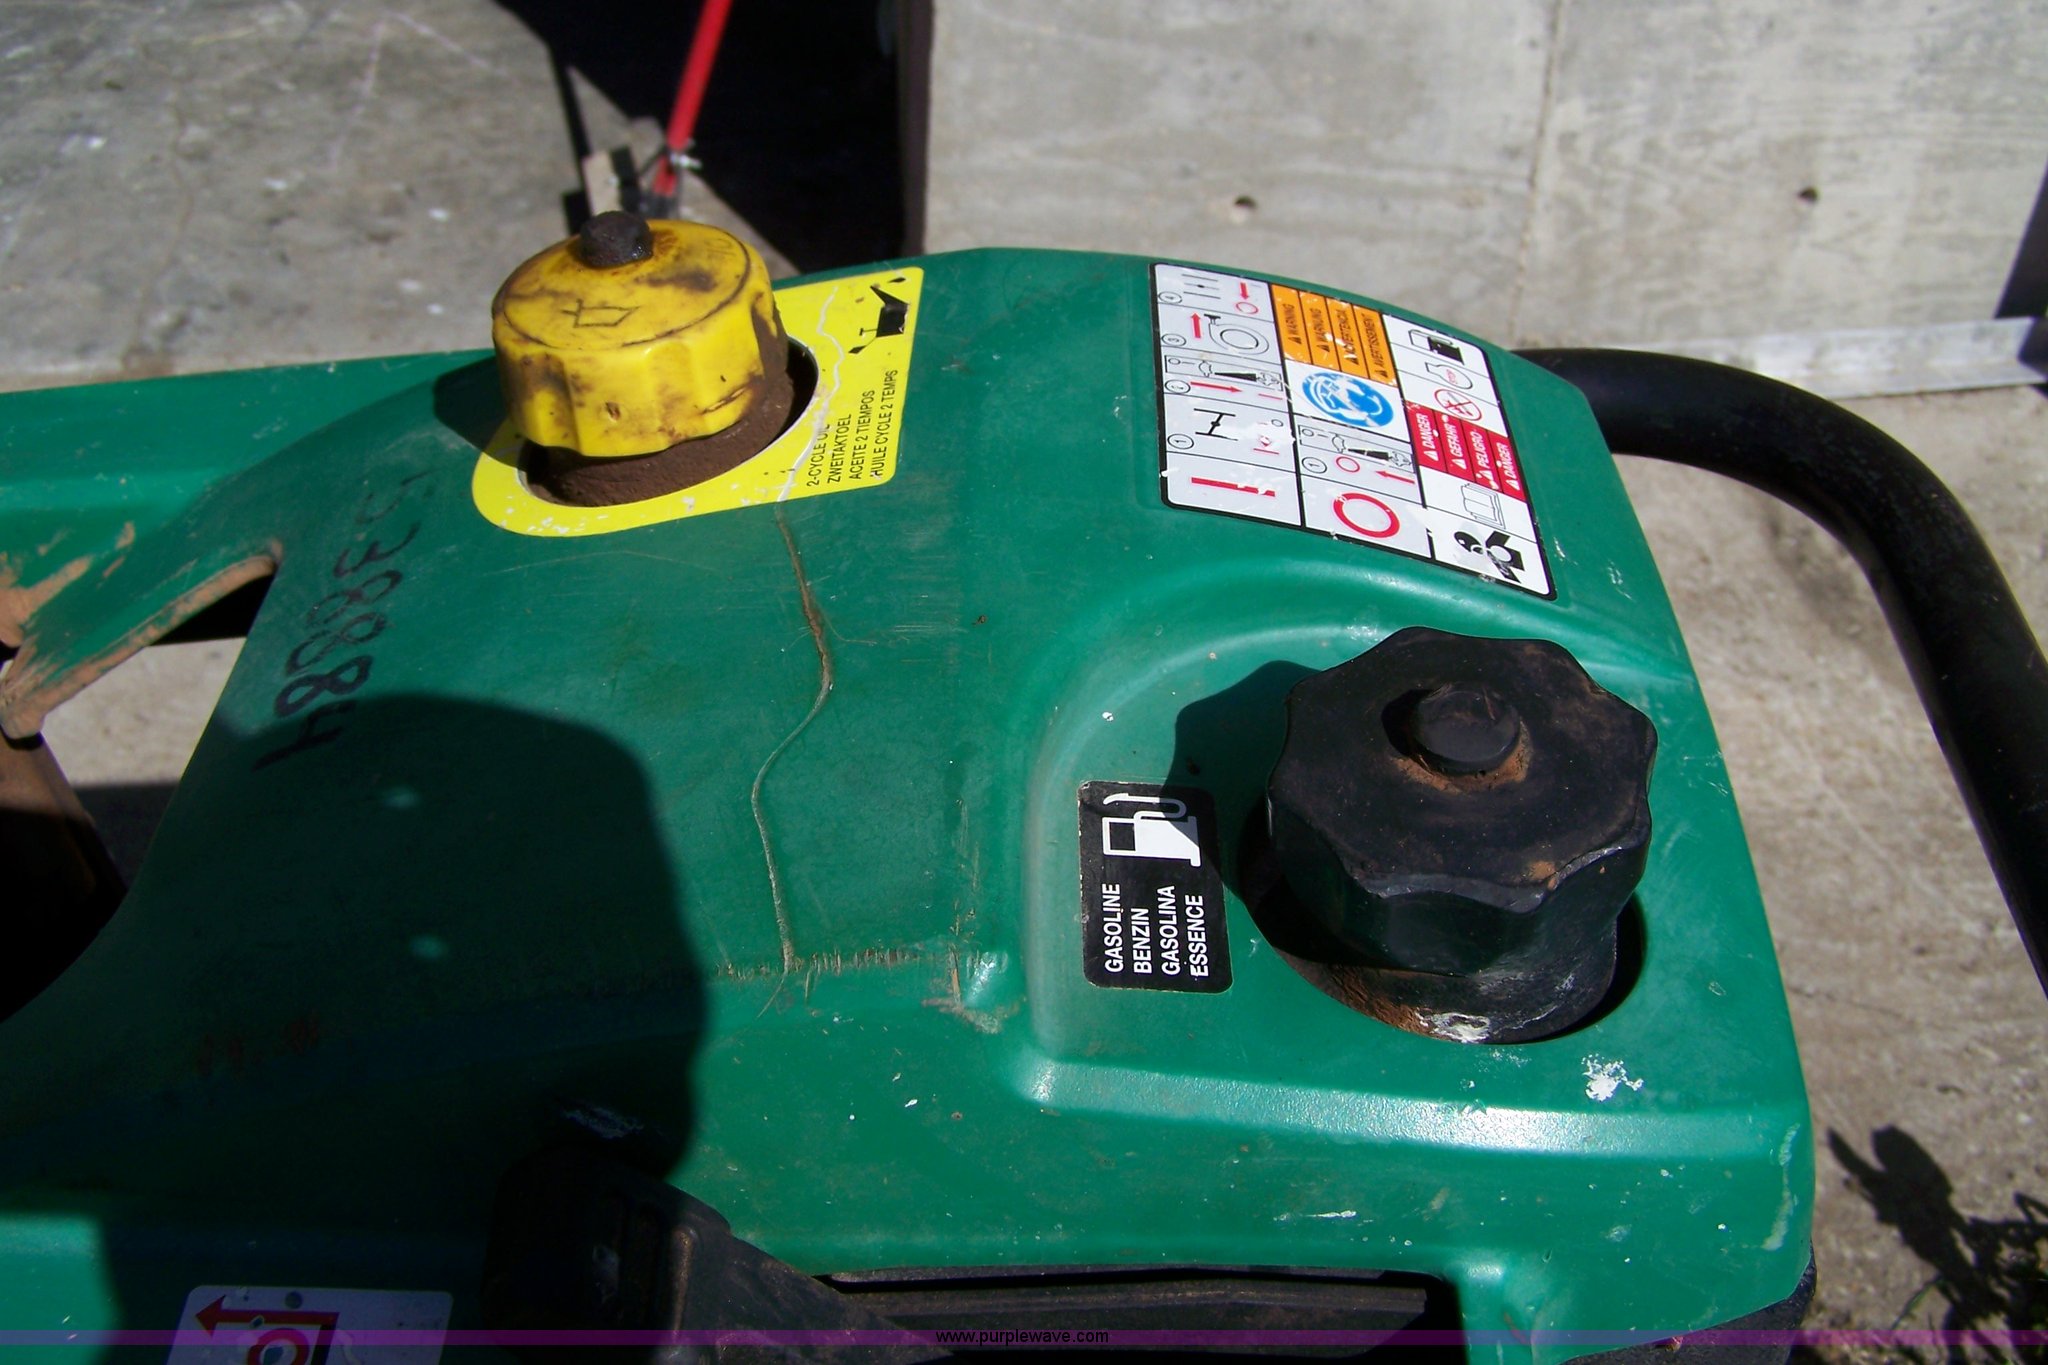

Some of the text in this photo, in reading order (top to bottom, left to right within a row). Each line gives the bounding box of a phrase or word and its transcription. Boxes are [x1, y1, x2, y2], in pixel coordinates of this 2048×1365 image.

[1282, 303, 1299, 337] WARNING
[881, 369, 898, 402] TEMPS
[856, 390, 876, 435] TIEMPOS
[874, 412, 893, 445] CYCLE
[1416, 412, 1436, 449] DANGER
[827, 414, 852, 484] ZWEITAKTOEL
[1443, 423, 1463, 457] GEFAHR
[1470, 431, 1490, 469] PELIGRO
[806, 442, 827, 487] 2-CYCLE
[849, 444, 868, 480] ACEITE
[870, 446, 888, 478] HUILE
[1496, 442, 1517, 479] DANGER
[1102, 883, 1124, 973] GASOLINE
[1130, 908, 1153, 974] BENZIN
[1157, 885, 1181, 975] GASOLINA
[1185, 895, 1209, 977] ESSENCE
